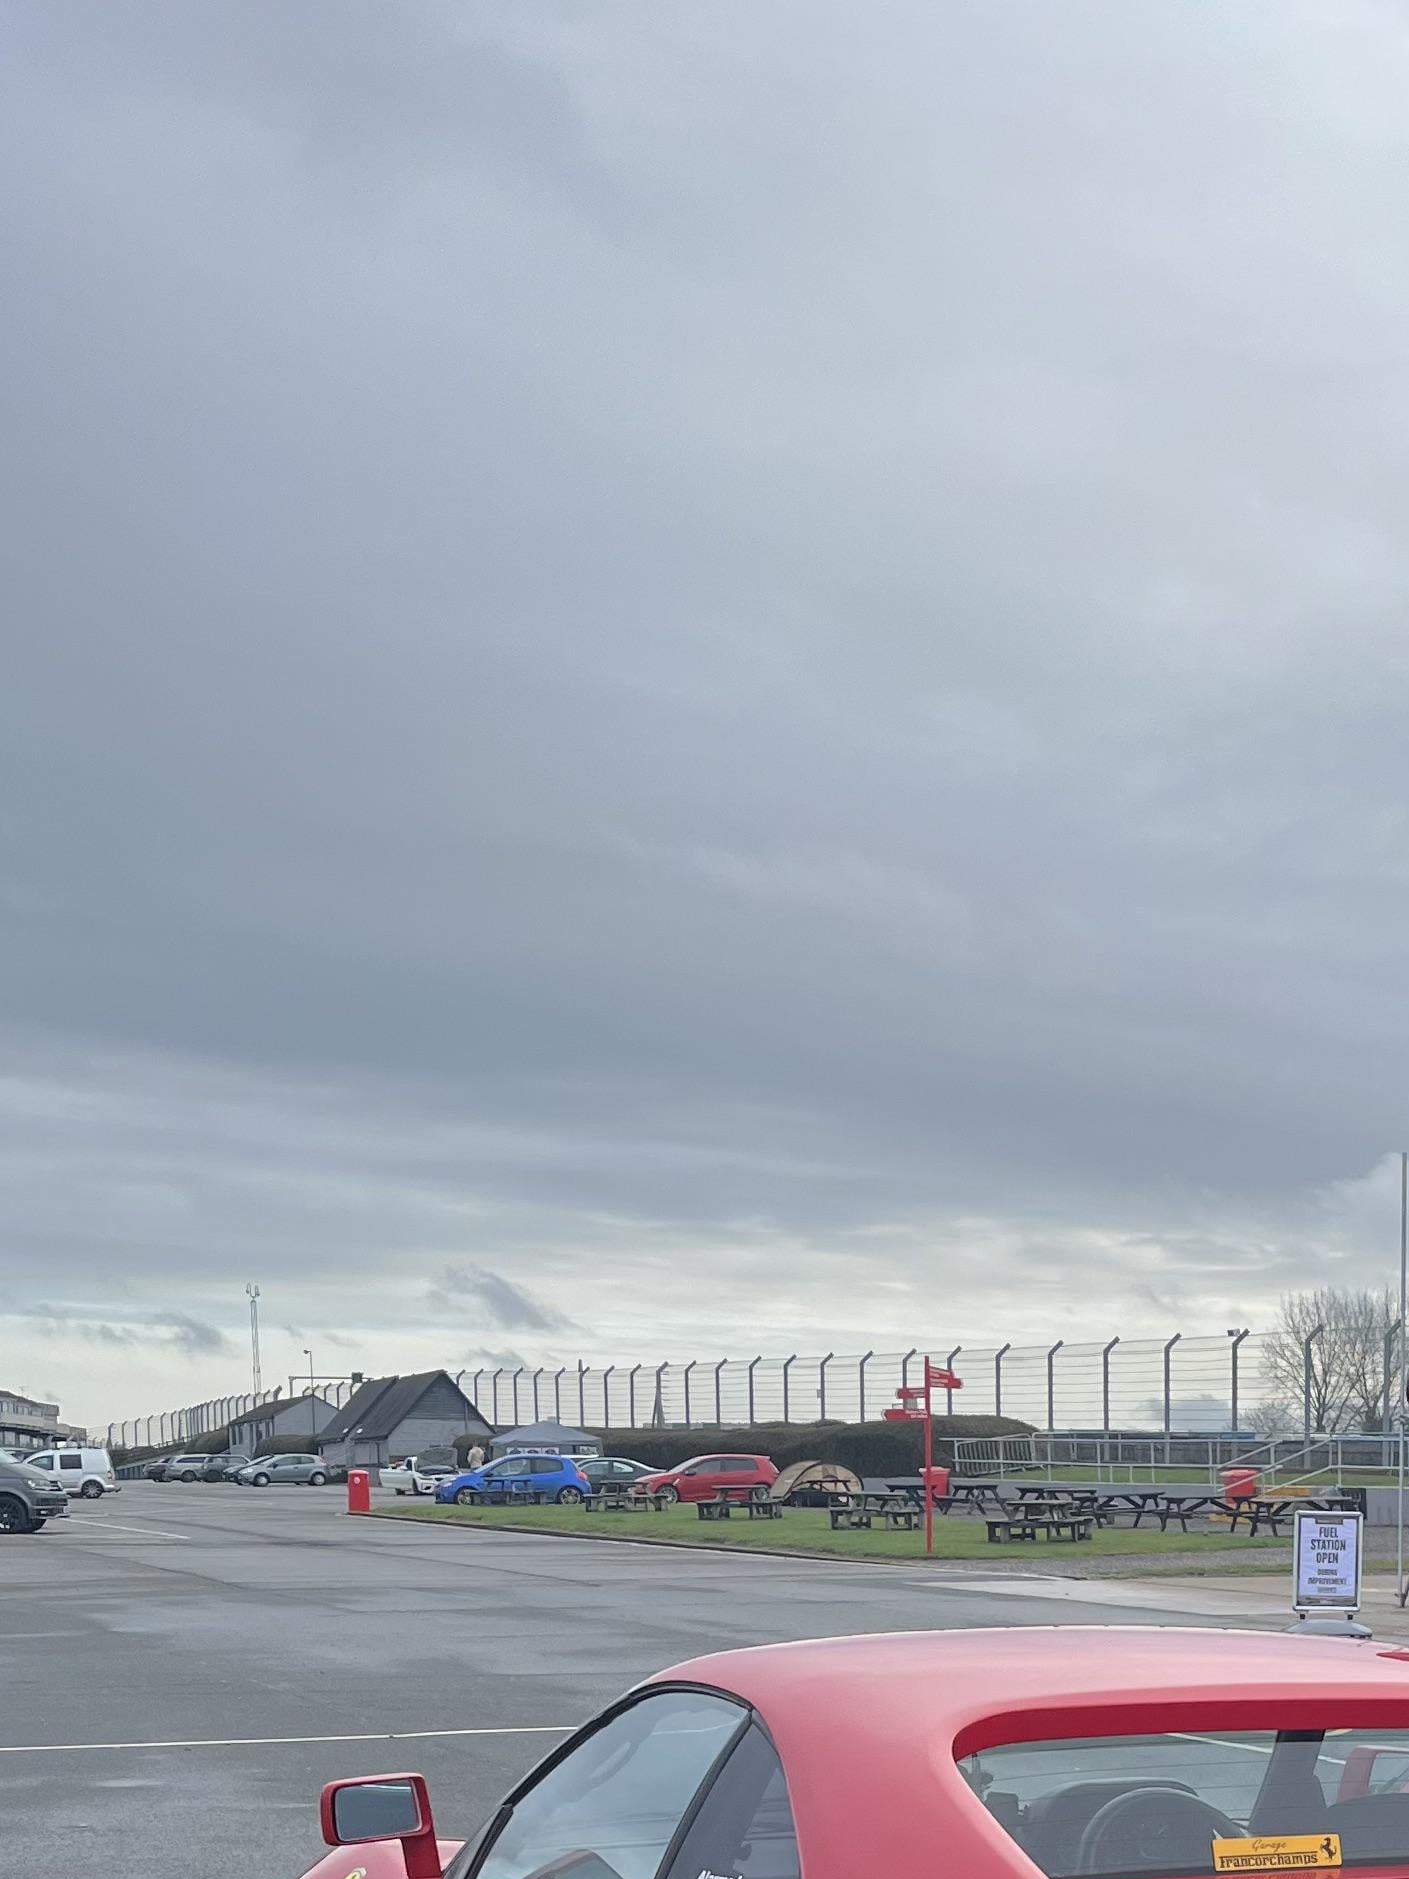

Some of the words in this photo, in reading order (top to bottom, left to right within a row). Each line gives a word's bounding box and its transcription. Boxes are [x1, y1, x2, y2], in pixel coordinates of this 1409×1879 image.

[1319, 1526, 1338, 1538] FUEL
[1310, 1539, 1346, 1551] STATION
[1316, 1552, 1339, 1564] OPEN
[1219, 1851, 1318, 1868] Francorchamps
